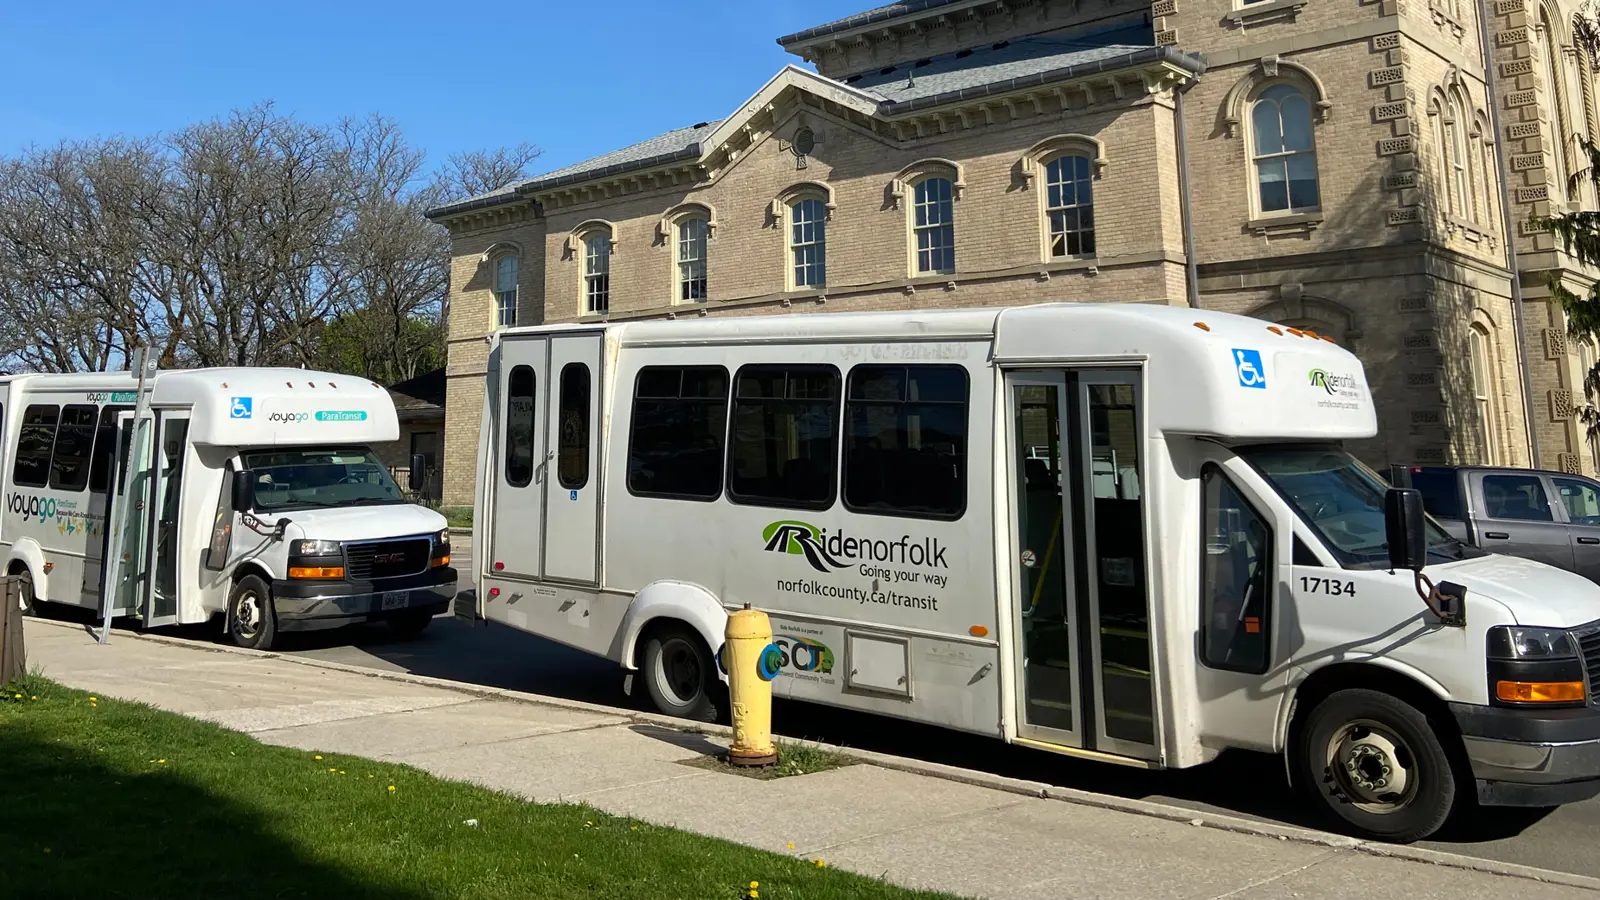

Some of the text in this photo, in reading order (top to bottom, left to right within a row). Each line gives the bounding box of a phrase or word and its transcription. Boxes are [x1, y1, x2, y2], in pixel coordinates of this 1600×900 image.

[321, 411, 363, 420] ParaTransit
[763, 526, 948, 573] Ridenorfolk
[859, 563, 948, 589] Going your way
[1300, 576, 1356, 597] 17134
[777, 579, 938, 611] norfolkcounty.ca/transit
